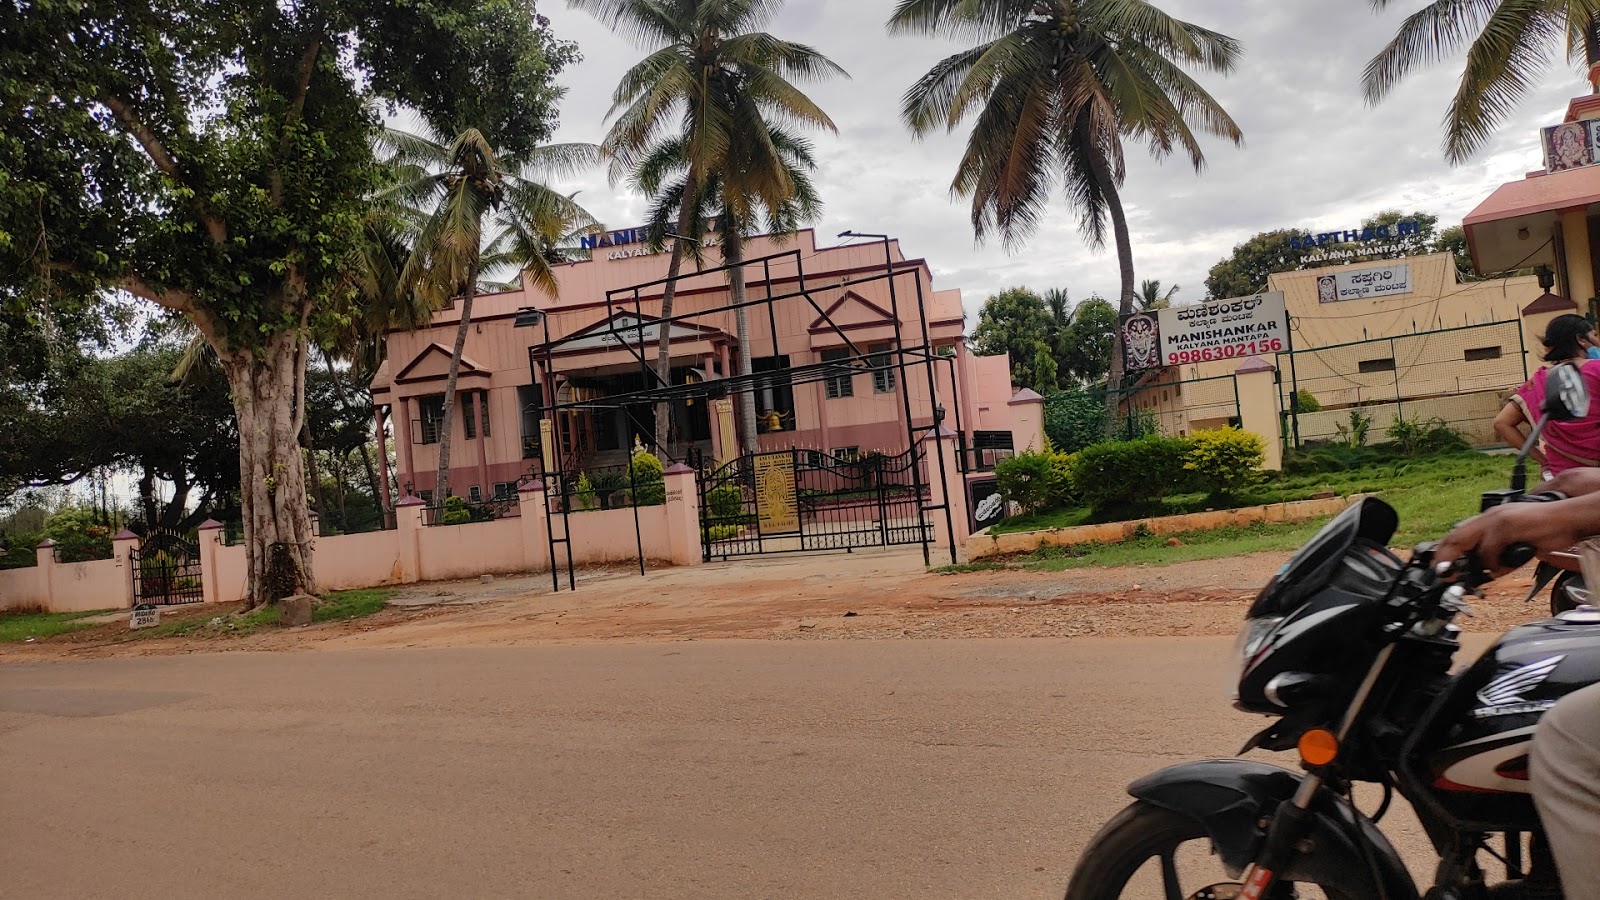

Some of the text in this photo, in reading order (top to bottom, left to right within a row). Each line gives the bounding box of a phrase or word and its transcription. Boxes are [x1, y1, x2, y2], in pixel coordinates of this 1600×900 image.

[606, 247, 652, 261] KALYAN
[1300, 242, 1413, 264] KALYANA MANTAPA
[1177, 295, 1263, 320] ಮಣಿಶಂಕರ್
[1168, 320, 1278, 344] MANISHANKAR
[1177, 332, 1270, 351] KALYANA MANTAPA
[1168, 338, 1282, 365] 9986302156
